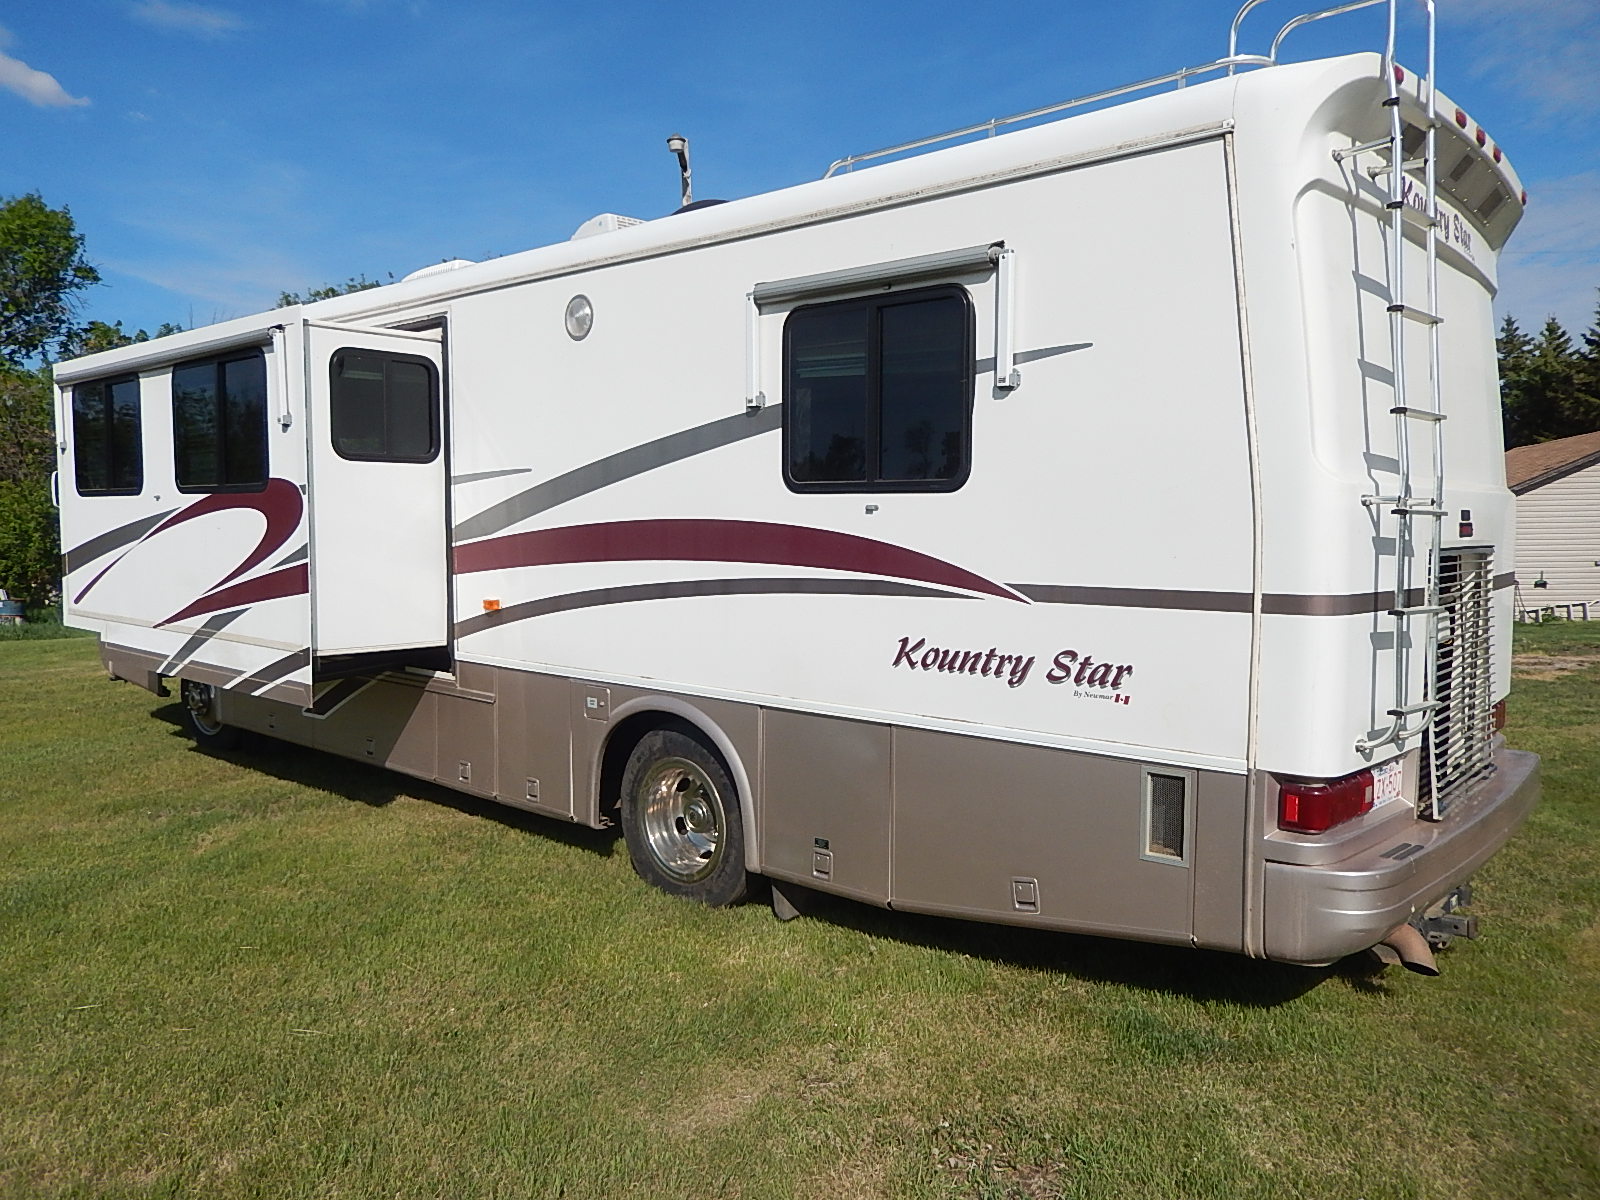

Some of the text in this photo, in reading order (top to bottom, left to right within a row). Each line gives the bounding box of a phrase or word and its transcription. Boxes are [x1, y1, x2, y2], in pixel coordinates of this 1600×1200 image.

[1401, 175, 1472, 252] Koutry Star
[891, 636, 1134, 691] Kountry Star
[1073, 690, 1114, 701] By Newmar
